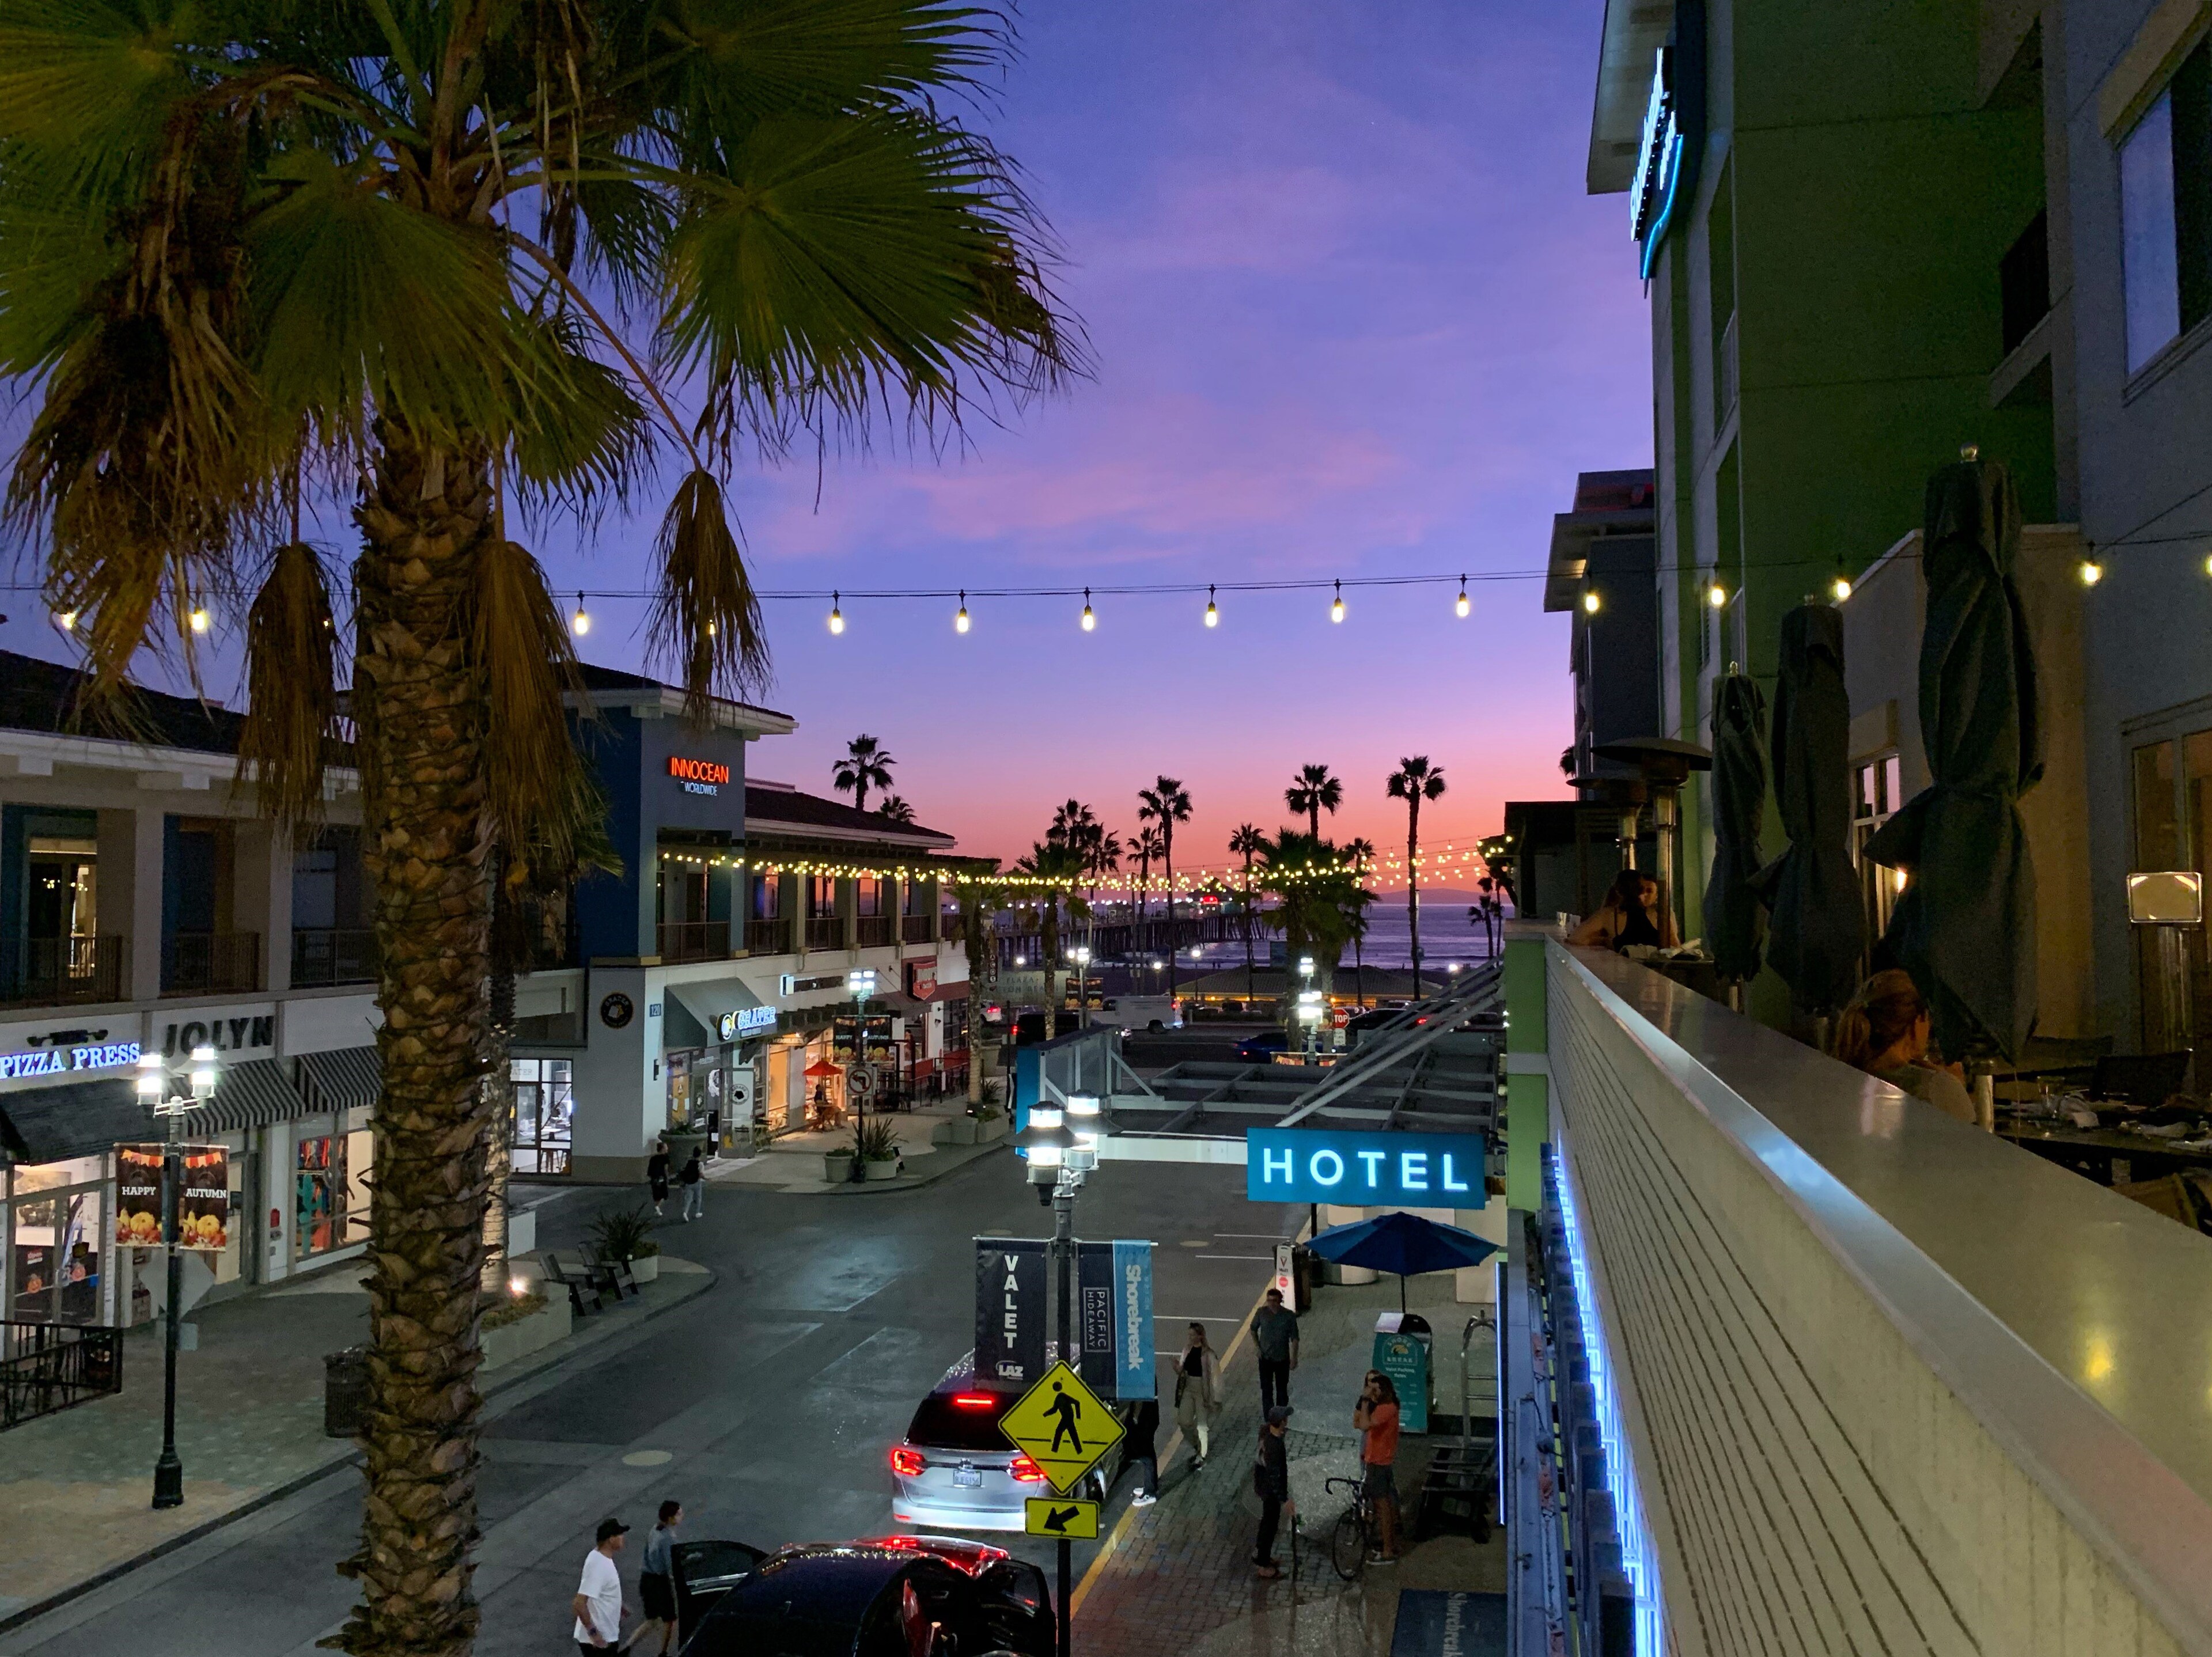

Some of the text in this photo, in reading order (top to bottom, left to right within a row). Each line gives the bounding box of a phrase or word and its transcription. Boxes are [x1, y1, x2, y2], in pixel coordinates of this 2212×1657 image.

[671, 757, 729, 784] INNOCEAN
[684, 782, 717, 796] WORLDWIDE
[651, 1004, 660, 1016] 120
[737, 1006, 777, 1030] GRATER
[1334, 1014, 1348, 1023] TOP
[162, 1015, 275, 1059] JOLYN
[0, 1042, 141, 1079] PIZZA PRESS
[1263, 1148, 1469, 1190] HOTEL
[122, 1186, 157, 1196] HAPPY
[185, 1188, 228, 1199] AUTUMN
[1003, 1254, 1020, 1348] VALET
[1086, 1291, 1095, 1347] HIDEAWAY
[1096, 1291, 1107, 1347] PACIFIC
[1126, 1264, 1144, 1371] Shorebreak
[998, 1364, 1024, 1378] LAZ
